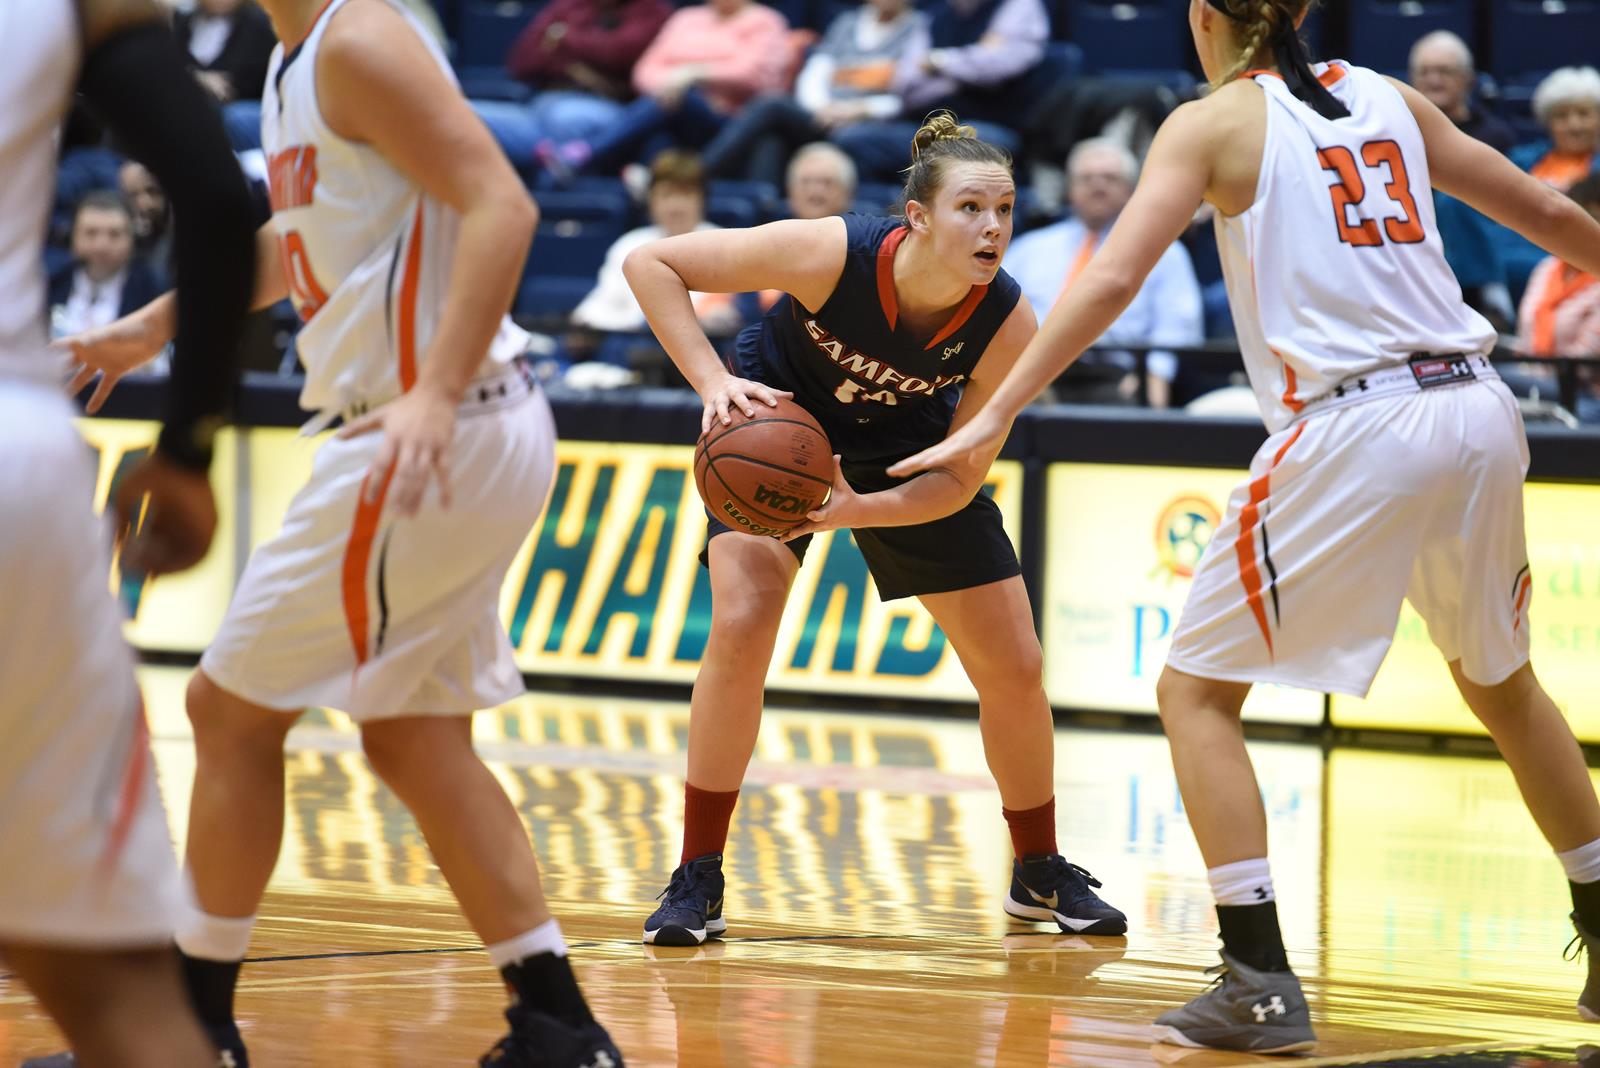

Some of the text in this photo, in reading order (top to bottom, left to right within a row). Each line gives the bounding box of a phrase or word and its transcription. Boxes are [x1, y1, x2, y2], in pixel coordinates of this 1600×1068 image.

[1316, 138, 1425, 247] 23
[721, 499, 788, 538] ilson
[753, 483, 813, 515] NCAA
